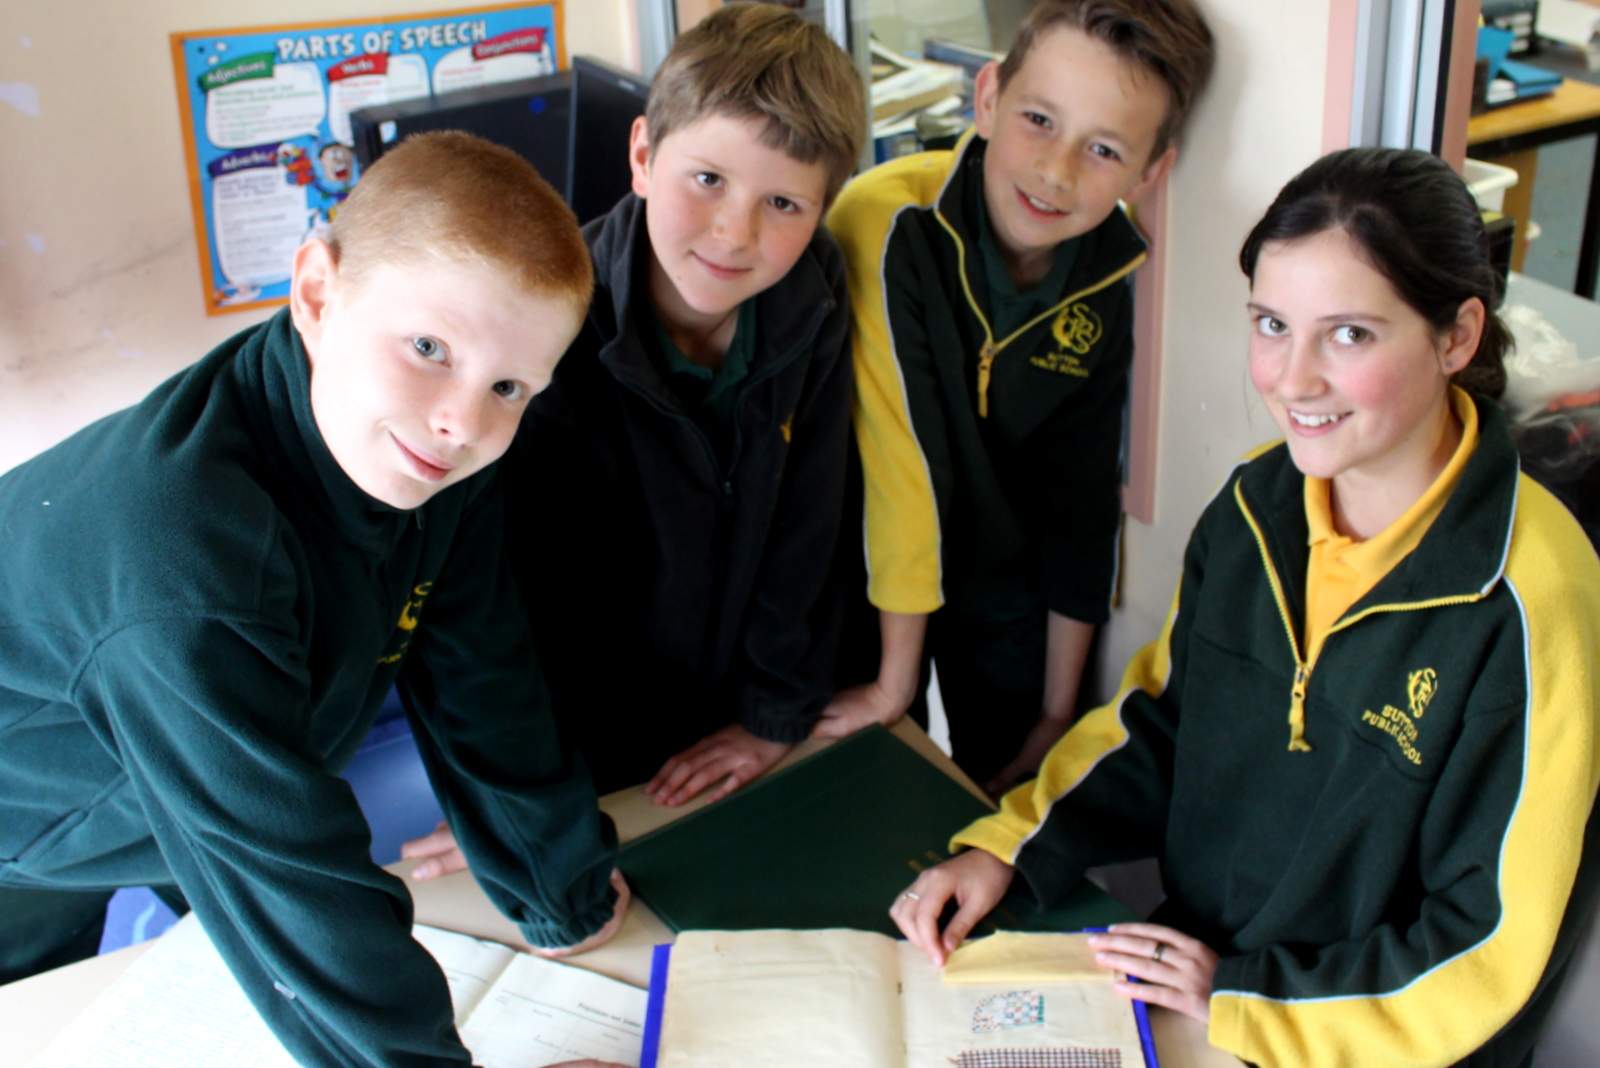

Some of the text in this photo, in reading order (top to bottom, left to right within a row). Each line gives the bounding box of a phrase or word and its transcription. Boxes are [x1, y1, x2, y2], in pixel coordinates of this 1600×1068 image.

[276, 20, 487, 62] PARTS OF SPEECH
[341, 58, 375, 75] Verbs
